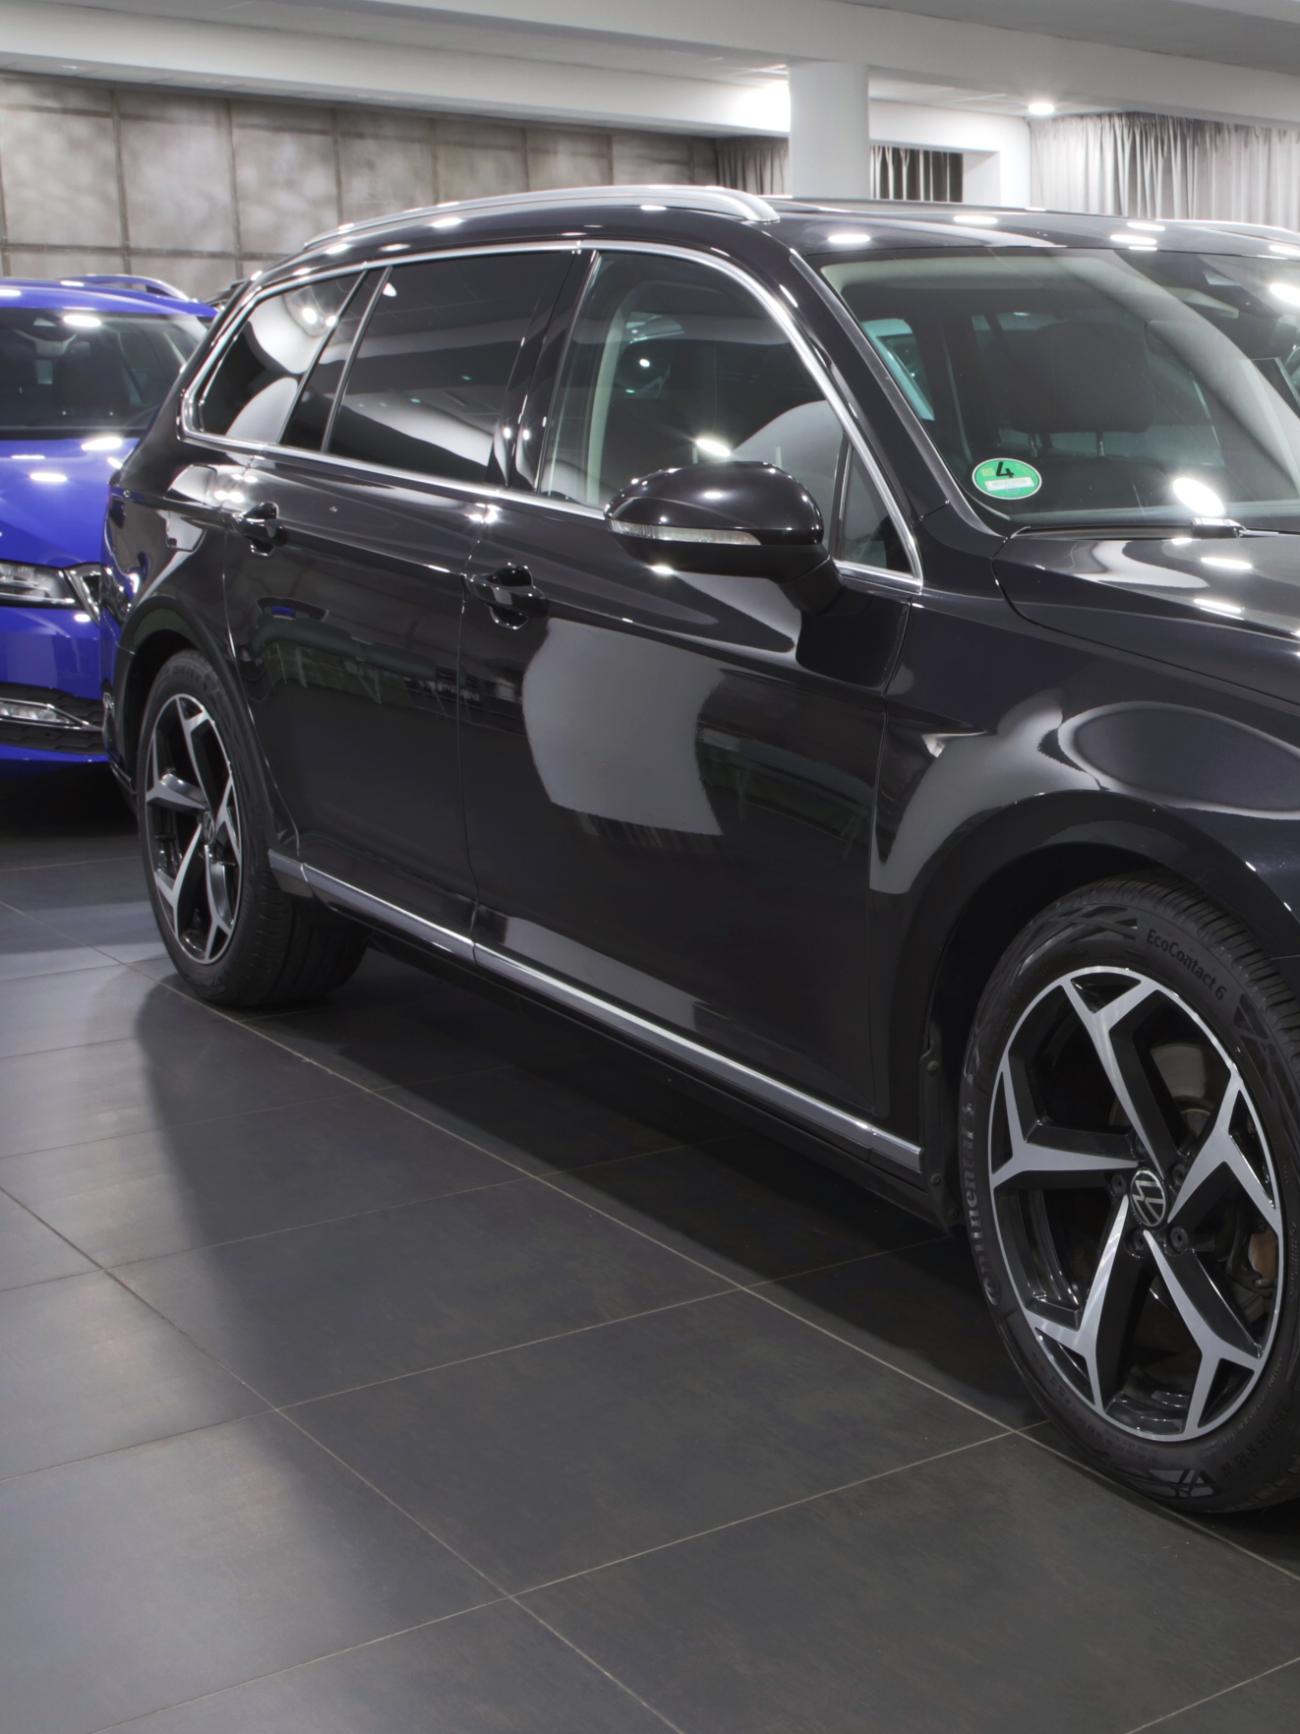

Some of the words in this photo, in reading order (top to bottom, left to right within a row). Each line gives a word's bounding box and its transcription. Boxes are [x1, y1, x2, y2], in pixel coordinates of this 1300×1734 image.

[996, 461, 1014, 478] 4
[1146, 928, 1217, 991] EcoContact
[1215, 985, 1228, 1001] 6
